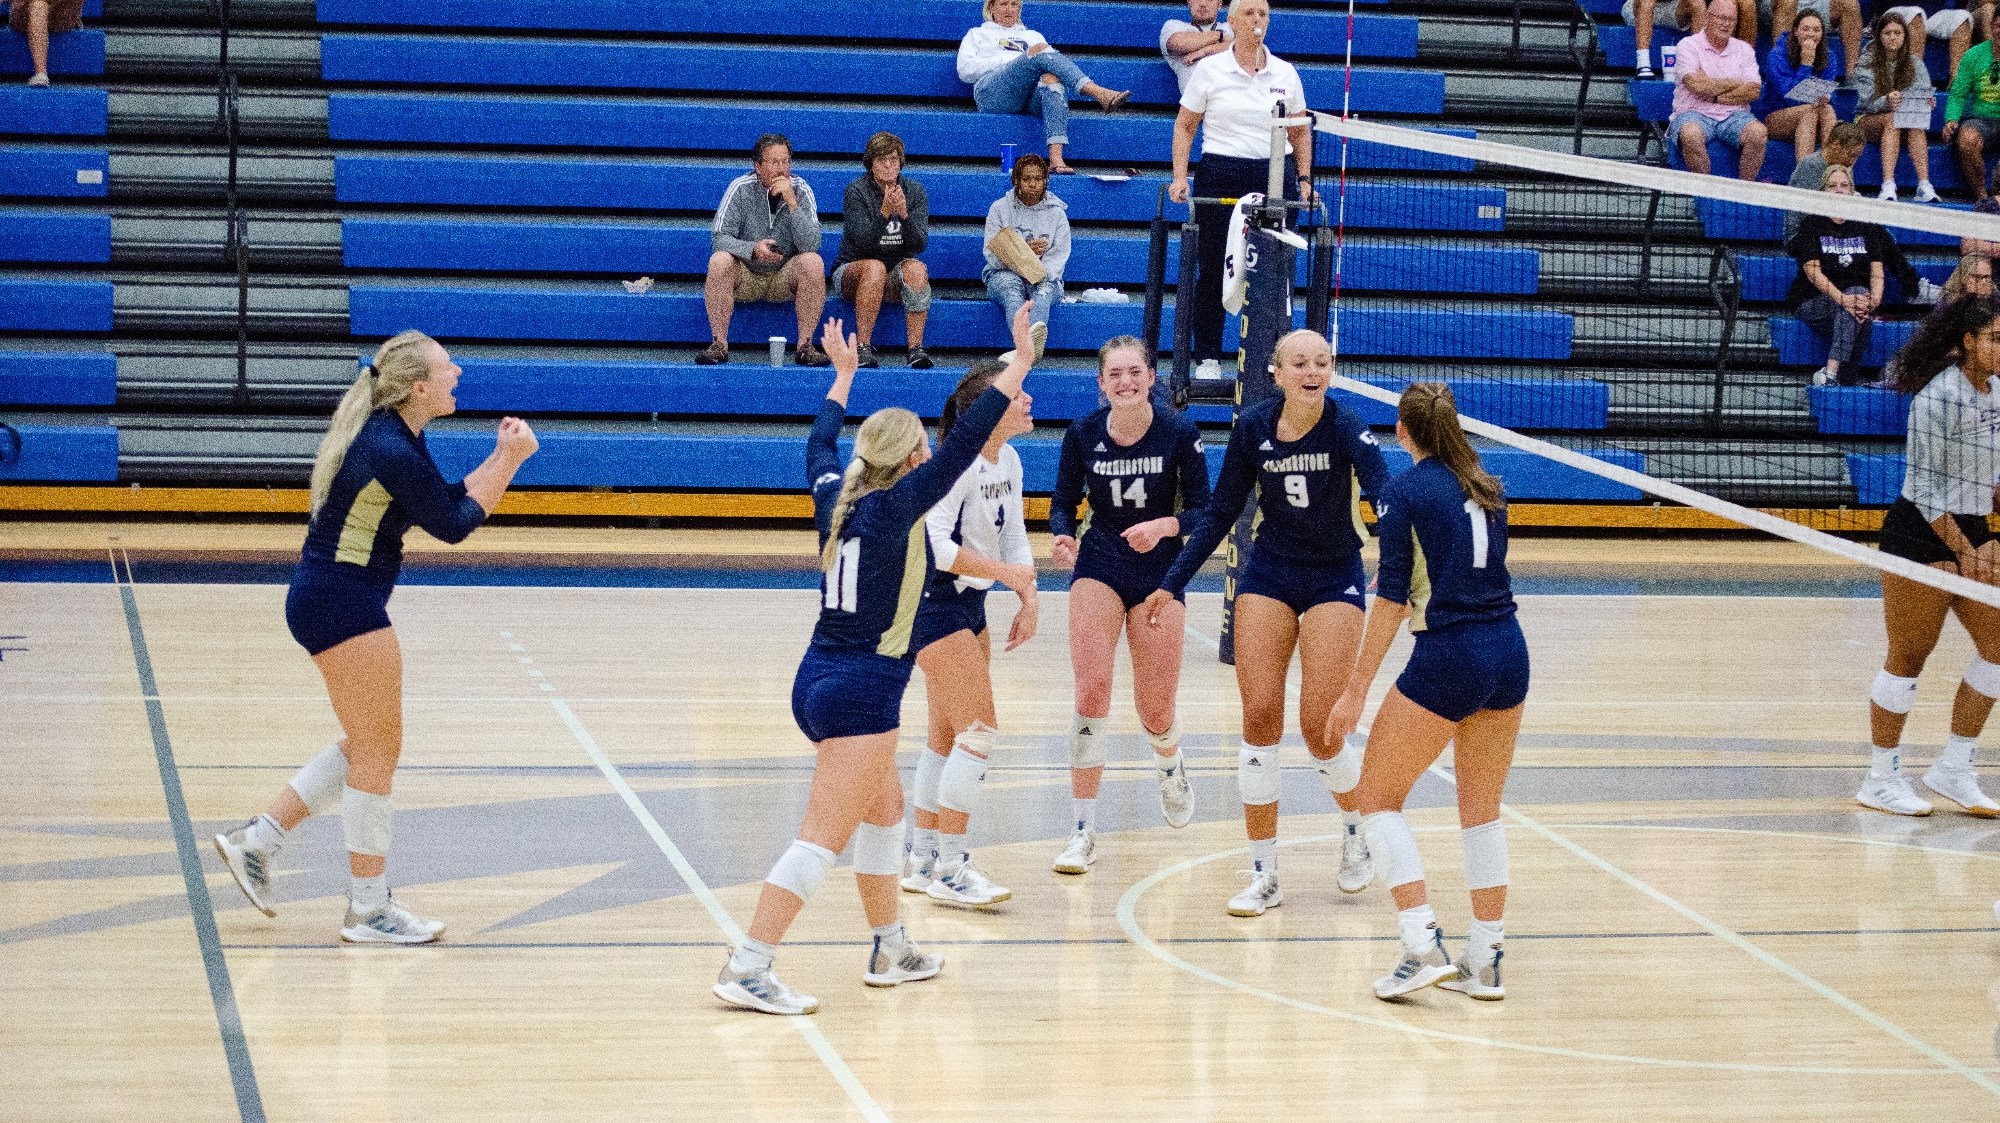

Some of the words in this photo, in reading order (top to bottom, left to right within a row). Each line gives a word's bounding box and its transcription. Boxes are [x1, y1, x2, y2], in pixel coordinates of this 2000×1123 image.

[1093, 456, 1164, 476] CORNERSTONE
[1109, 477, 1148, 509] 14
[1284, 474, 1310, 509] 9
[1463, 499, 1489, 569] 1
[824, 536, 861, 614] 11
